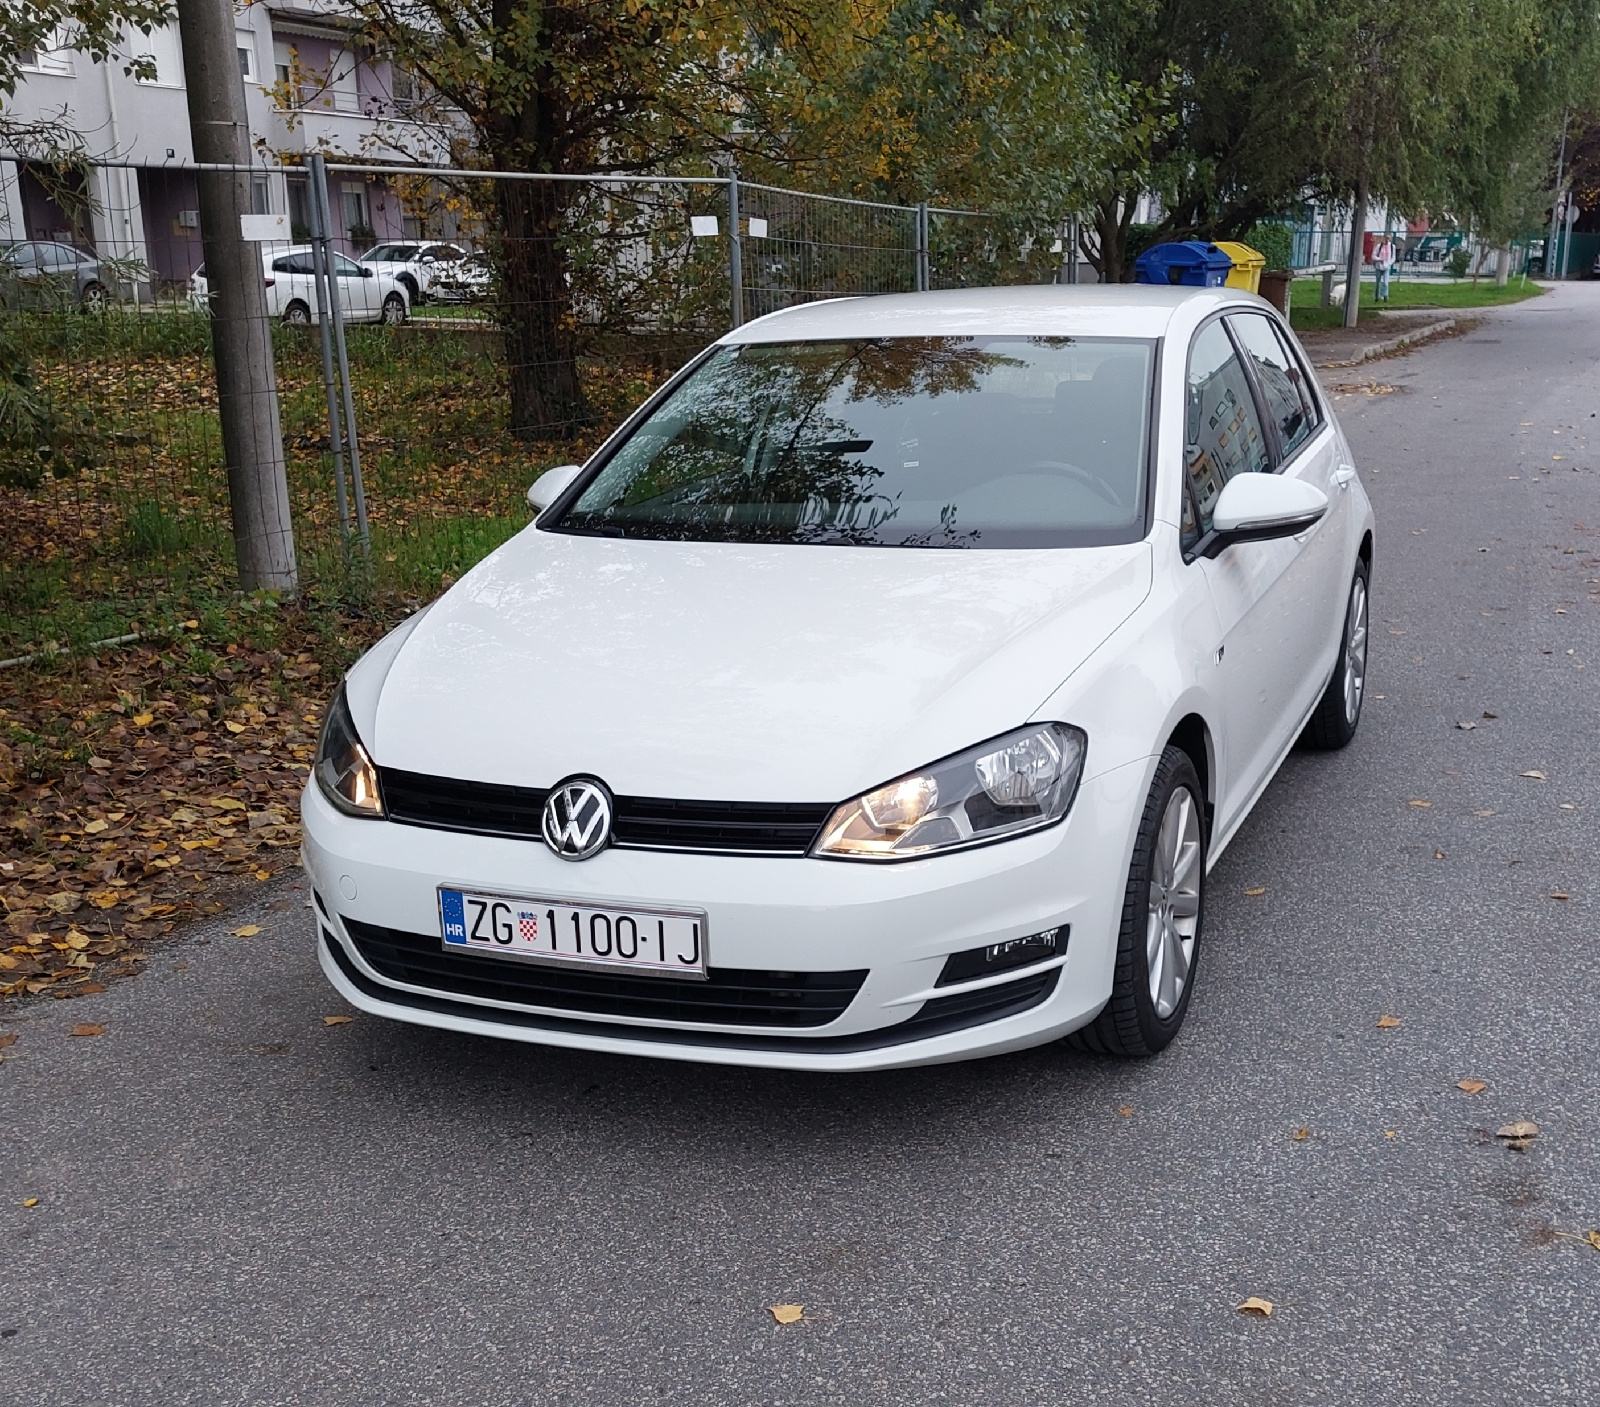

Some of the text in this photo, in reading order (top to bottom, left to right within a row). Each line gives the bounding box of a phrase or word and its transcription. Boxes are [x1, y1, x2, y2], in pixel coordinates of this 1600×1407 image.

[547, 782, 609, 854] VW
[446, 923, 464, 937] HR
[467, 899, 514, 945] ZG
